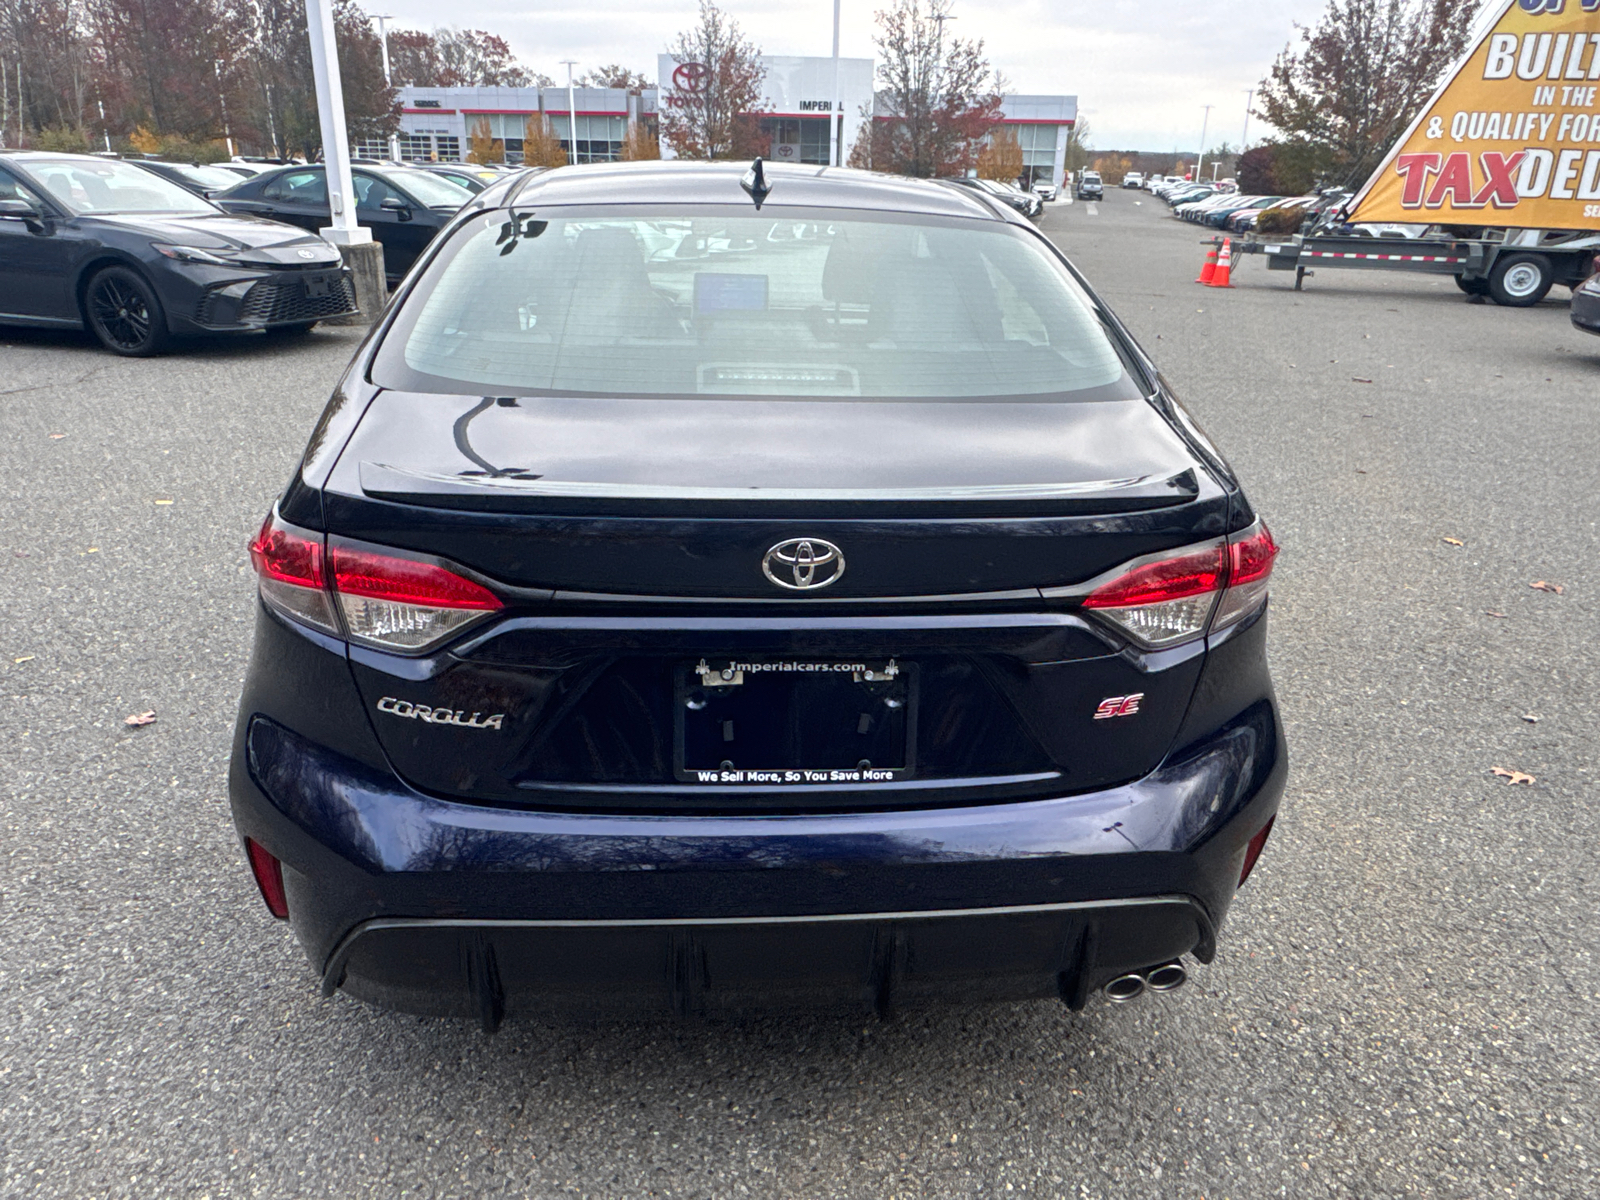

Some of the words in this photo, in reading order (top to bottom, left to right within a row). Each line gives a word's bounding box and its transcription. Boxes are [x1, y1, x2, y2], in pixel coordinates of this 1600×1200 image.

[799, 100, 844, 111] IMPERIL
[1532, 85, 1556, 106] IN
[1561, 86, 1598, 107] THE
[1426, 116, 1444, 139] &
[1450, 111, 1555, 142] QUALIFY
[1556, 113, 1600, 142] FOR
[1396, 151, 1529, 209] TAX
[729, 661, 867, 674] Imperialcars.com
[376, 696, 505, 730] COROLLA
[1093, 692, 1144, 720] SE
[697, 772, 719, 782] We
[720, 771, 744, 782] Sell
[747, 771, 782, 784] More,
[784, 771, 801, 782] So
[803, 771, 828, 782] You
[830, 770, 860, 781] Save
[862, 770, 894, 780] More
